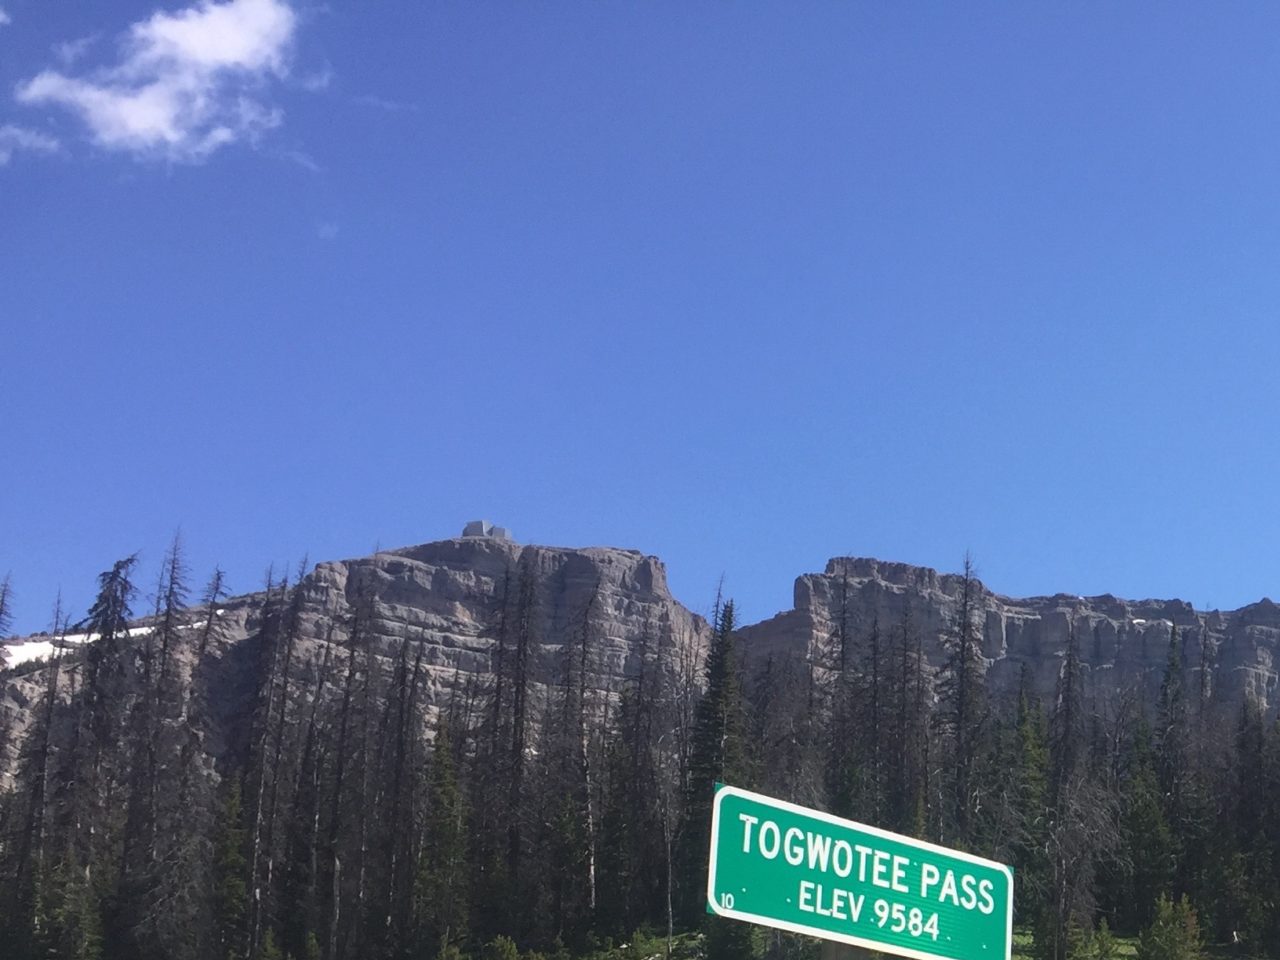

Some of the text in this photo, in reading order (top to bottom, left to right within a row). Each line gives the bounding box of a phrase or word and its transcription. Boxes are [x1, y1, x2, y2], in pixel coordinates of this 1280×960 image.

[739, 813, 995, 915] TOGWOTEE PASS
[720, 892, 735, 909] 10
[799, 880, 940, 941] ELEV 9584
